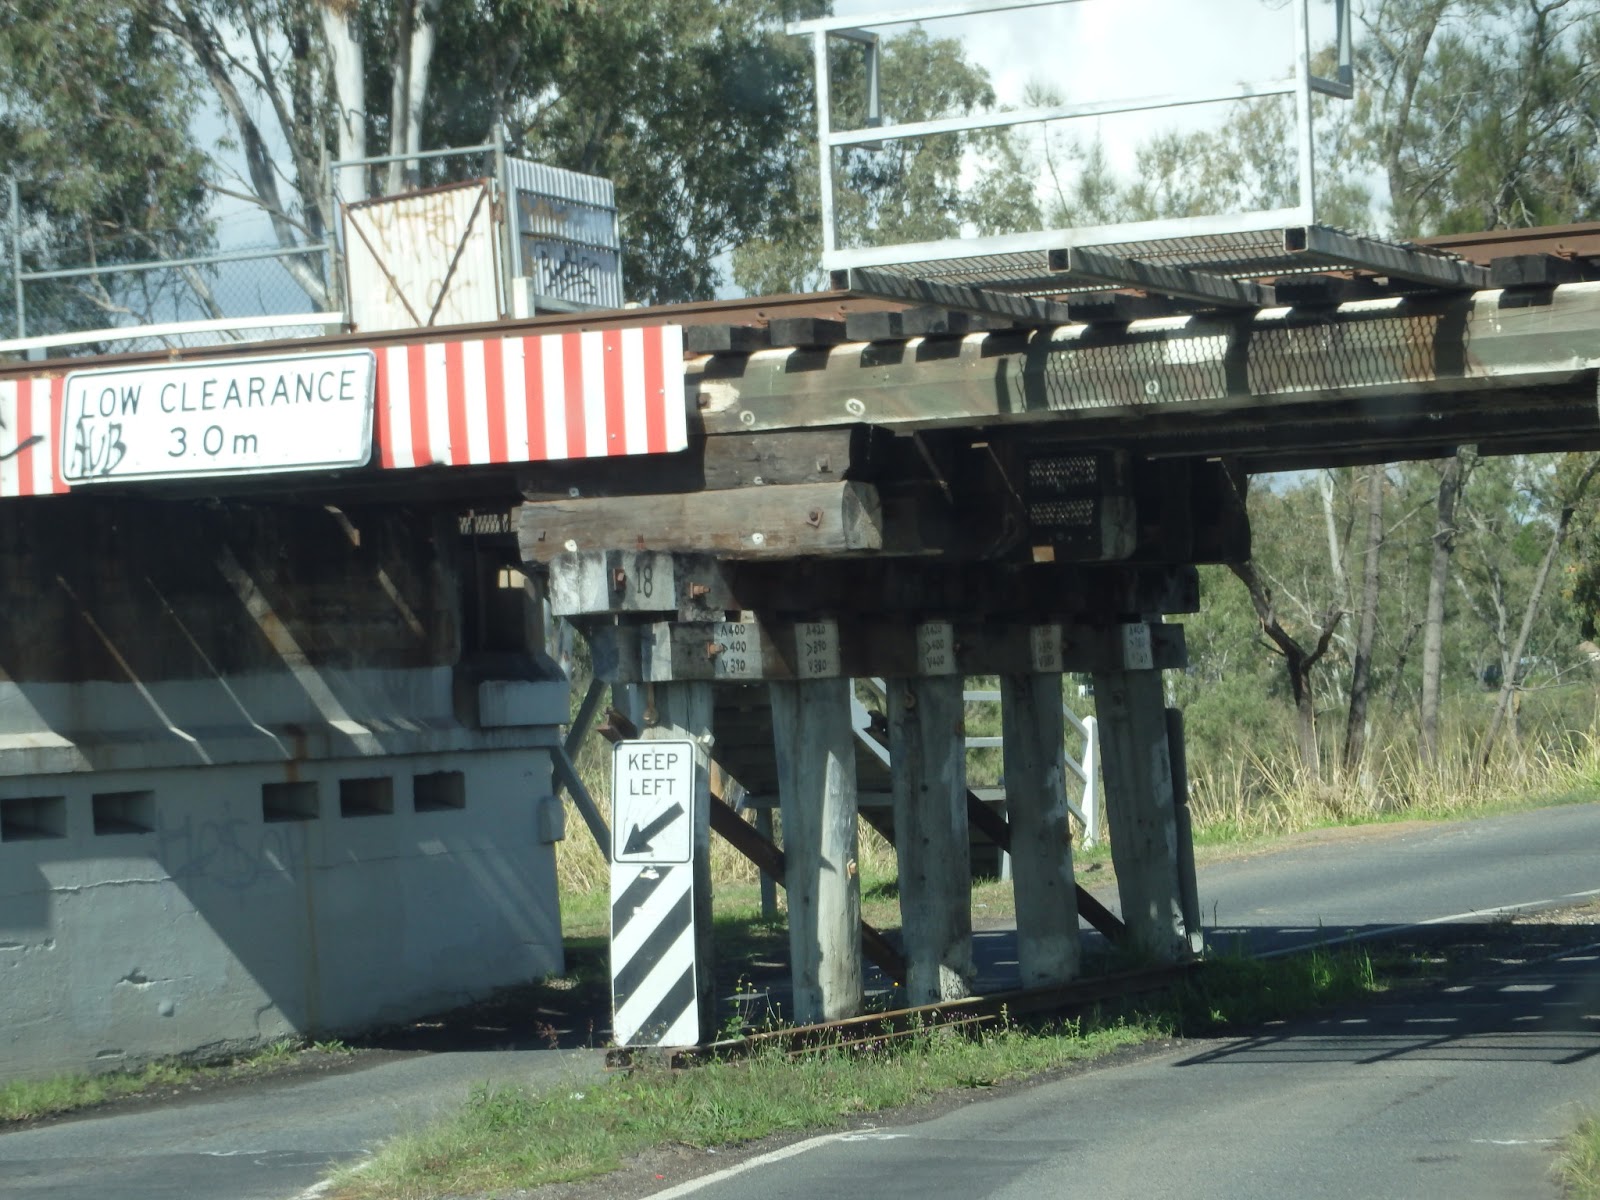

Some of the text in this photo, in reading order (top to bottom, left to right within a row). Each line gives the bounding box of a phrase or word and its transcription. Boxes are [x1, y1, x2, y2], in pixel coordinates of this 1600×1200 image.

[80, 369, 356, 419] LOW CLEARANCE
[636, 566, 654, 599] 18
[628, 753, 679, 771] KEEP
[629, 778, 677, 796] LEFT
